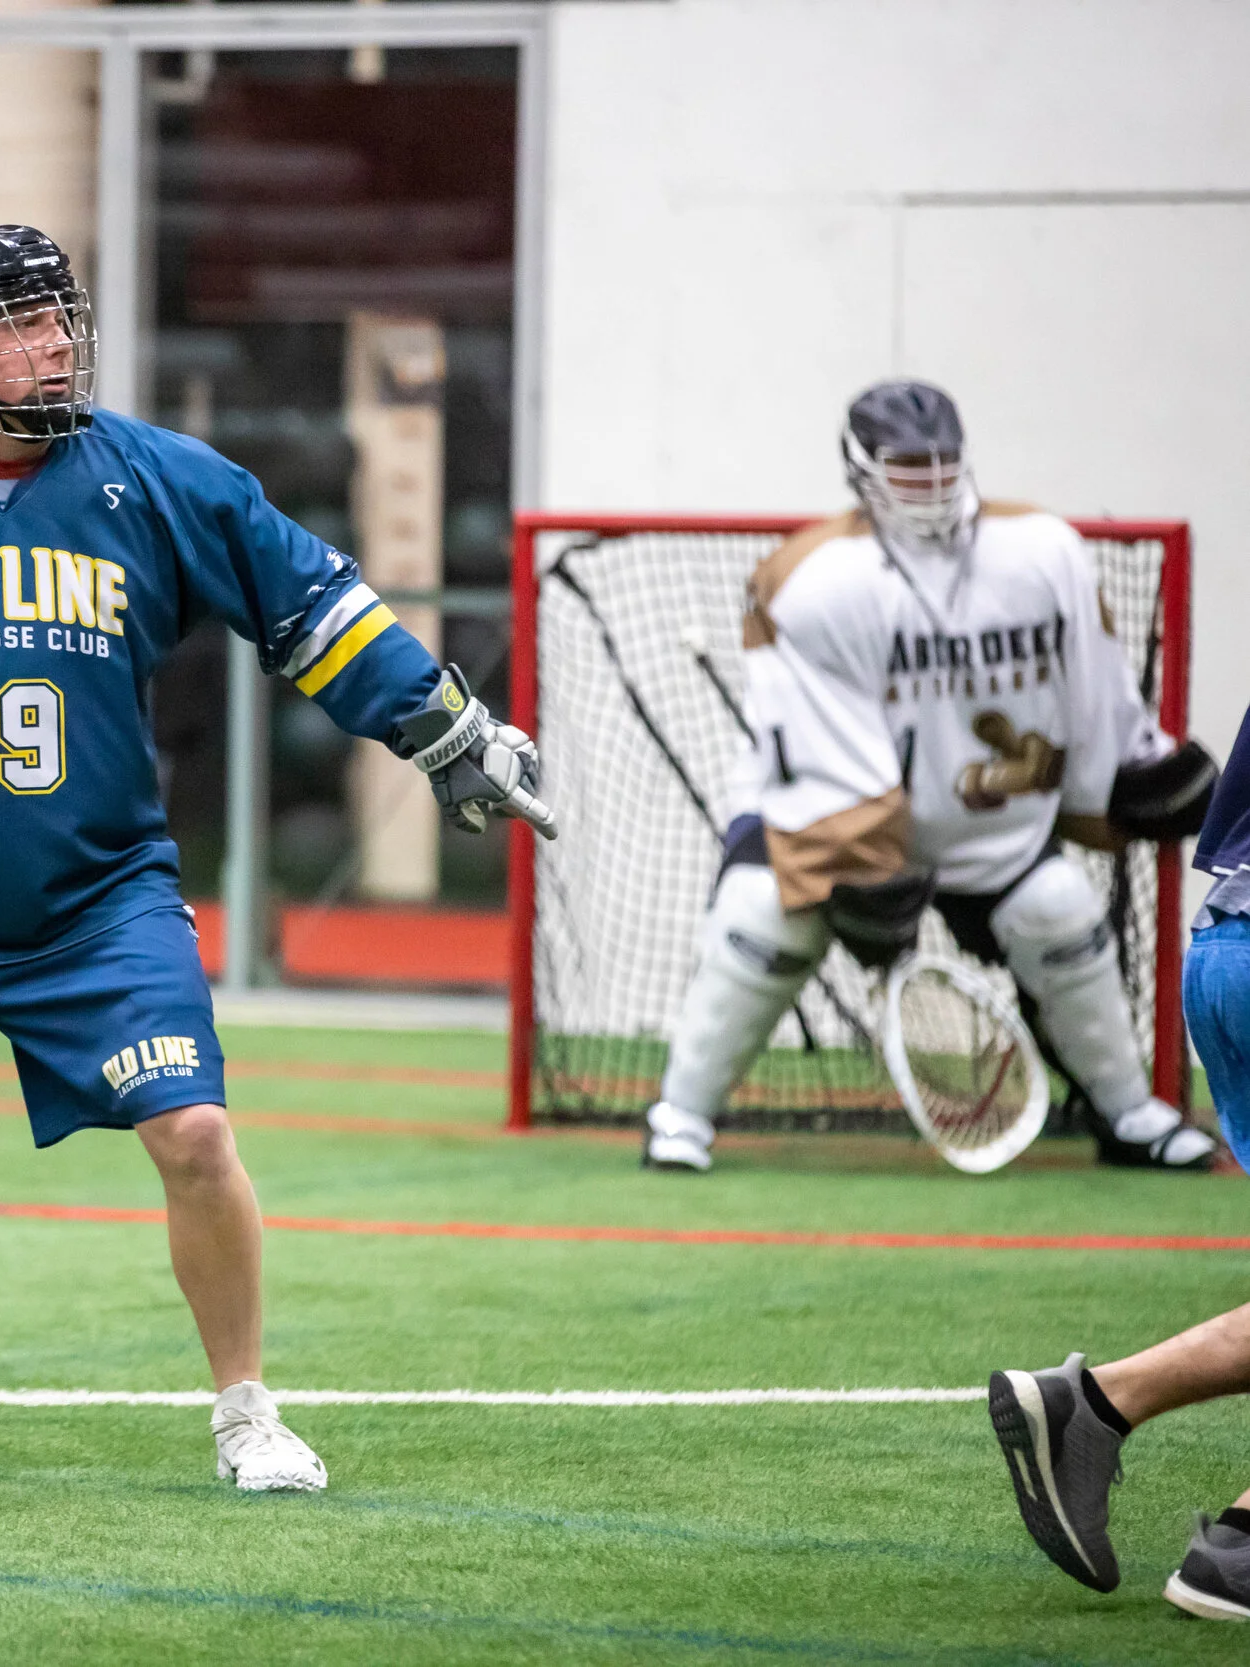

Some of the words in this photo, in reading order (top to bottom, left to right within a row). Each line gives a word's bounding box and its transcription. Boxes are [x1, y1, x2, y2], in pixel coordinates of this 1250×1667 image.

[0, 546, 128, 636] LINE
[48, 628, 109, 658] CLUB
[102, 1046, 139, 1091] OLD
[138, 1036, 200, 1070] LINE
[118, 1069, 160, 1099] LACROSSE
[163, 1067, 194, 1077] CLUB
